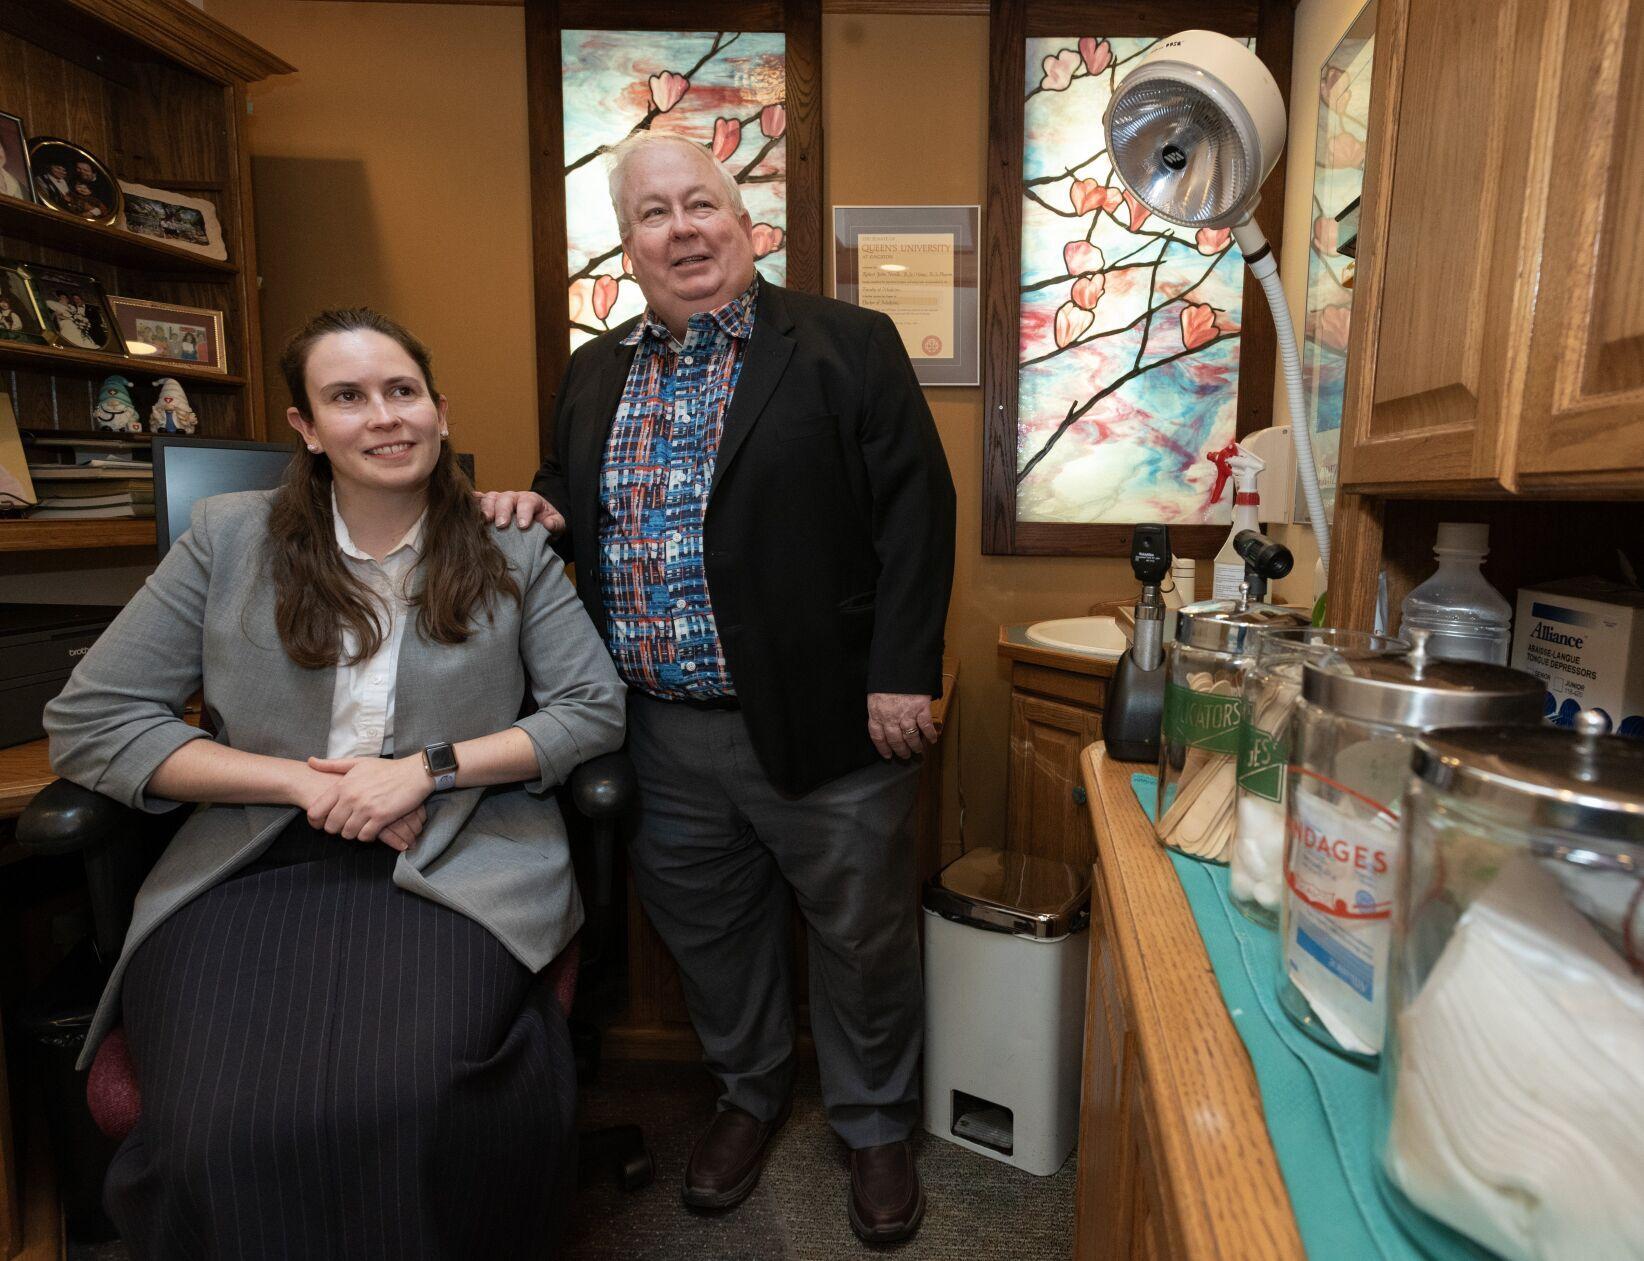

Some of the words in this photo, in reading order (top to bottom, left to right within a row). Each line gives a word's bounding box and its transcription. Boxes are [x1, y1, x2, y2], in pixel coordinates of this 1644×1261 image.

[861, 243, 898, 254] QUEEN'S
[900, 243, 951, 253] UNIVERSITY
[1530, 621, 1583, 649] Alliance
[69, 647, 89, 656] broth
[1528, 644, 1581, 664] ABAISSE-LANGUE
[1527, 652, 1549, 666] TONGUE
[1550, 660, 1597, 680] DEPRESSORS
[1565, 680, 1585, 691] JUNIOR
